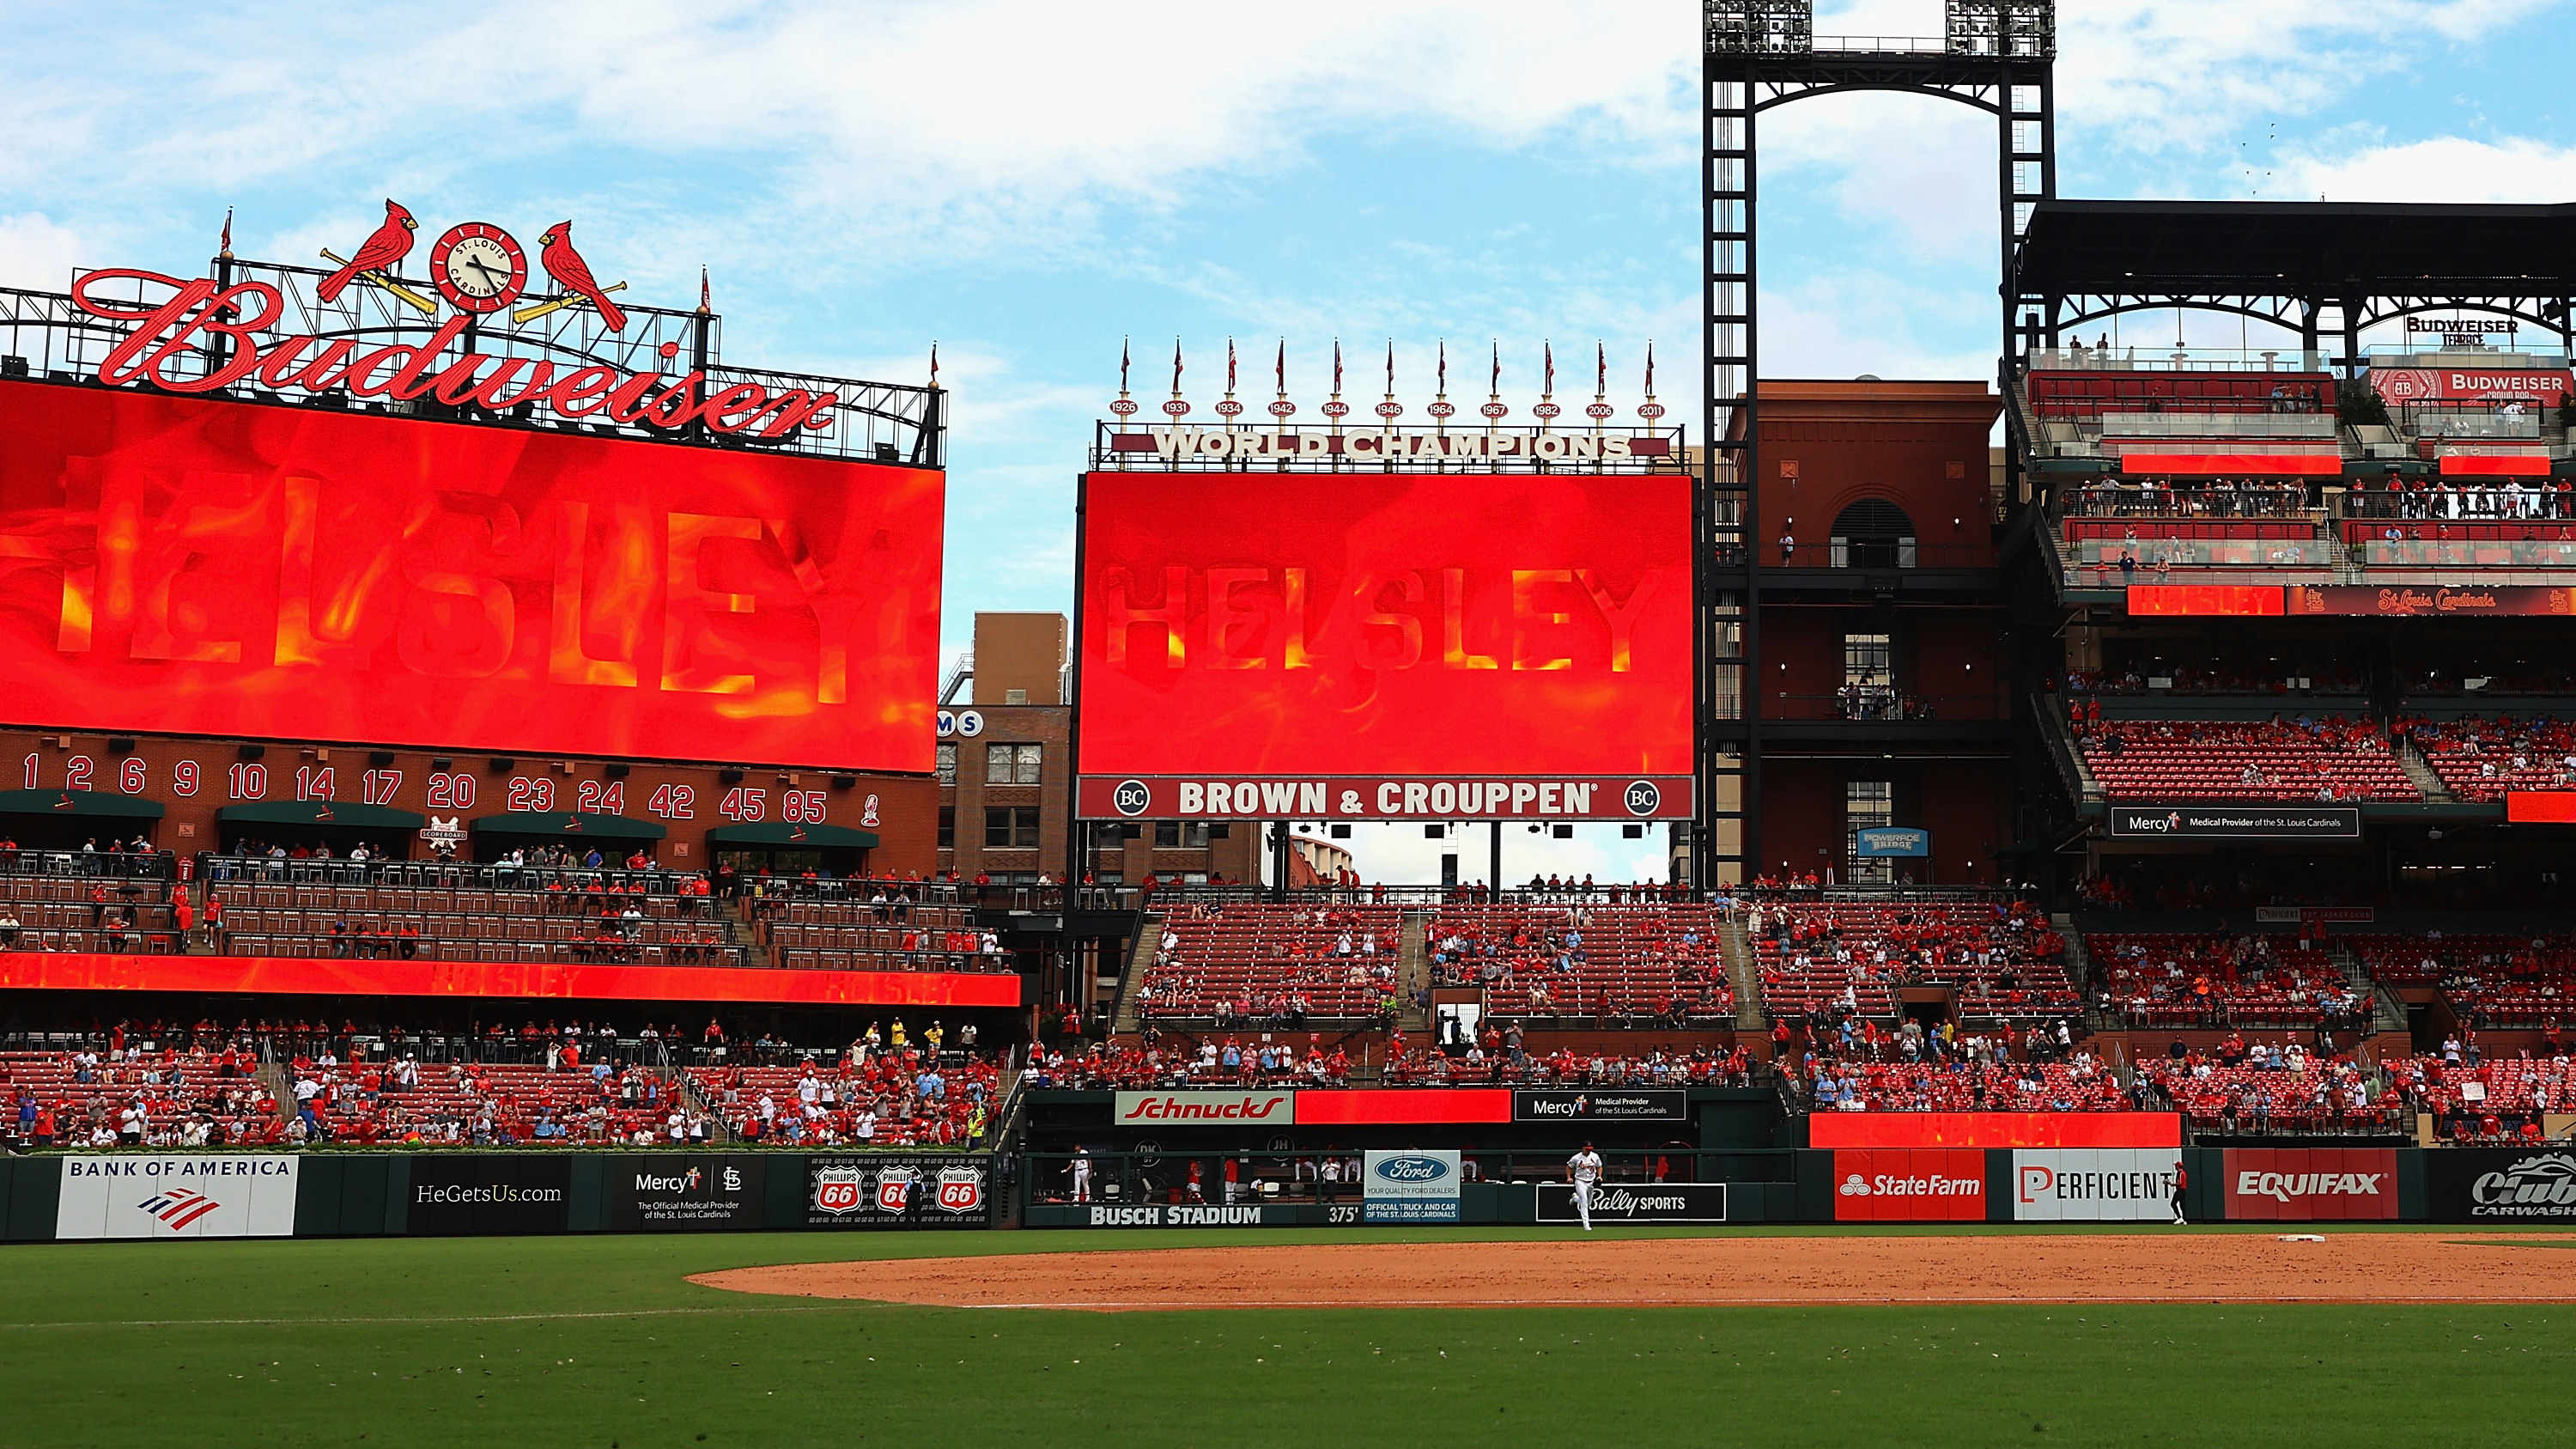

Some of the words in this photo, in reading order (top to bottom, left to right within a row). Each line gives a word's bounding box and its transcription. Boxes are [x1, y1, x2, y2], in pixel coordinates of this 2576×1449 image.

[456, 243, 471, 254] ST.
[474, 240, 506, 259] LOUIS
[451, 268, 508, 295] CARDINLS
[2407, 317, 2518, 333] BUDWEISER
[2442, 334, 2483, 345] TERRACE
[72, 267, 839, 439] Budweiser
[2451, 374, 2563, 390] BUDWEISER
[1112, 403, 1136, 412] 1926
[1165, 403, 1188, 412] 1931
[1218, 404, 1241, 412] 1934
[1270, 404, 1293, 413] 1942
[1323, 404, 1347, 413] 1944
[1377, 405, 1400, 414] 1946
[1430, 405, 1453, 414] 1964
[1483, 405, 1506, 415] 1967
[1535, 405, 1558, 415] 1982
[1588, 406, 1613, 416] 2006
[1640, 406, 1662, 416] 2011
[1151, 428, 1329, 460] WORLD
[1343, 429, 1631, 460] CHAMPIONS
[2397, 589, 2433, 612] Louis
[2436, 588, 2496, 611] Cardinals
[1106, 567, 1657, 673] HELSLEY
[25, 753, 39, 789] 1
[66, 756, 94, 792] 2
[120, 758, 146, 794] 6
[173, 760, 200, 796] 9
[229, 763, 267, 799] 10
[296, 766, 335, 801] 14
[363, 769, 403, 805] 17
[427, 773, 476, 808] 20
[507, 776, 555, 813] 23
[577, 780, 624, 815] 24
[1121, 789, 1144, 807] BC
[1179, 782, 1327, 814] BROWN
[1340, 789, 1364, 813] &
[1631, 789, 1655, 807] BC
[647, 783, 695, 819] 42
[720, 787, 766, 822] 45
[782, 790, 826, 825] 85
[2129, 817, 2169, 832] Mercy
[2190, 818, 2221, 826] Medical
[2221, 818, 2254, 826] Provider
[2255, 818, 2262, 826] of
[2263, 818, 2275, 826] the
[2276, 818, 2286, 826] St.
[2287, 818, 2306, 827] Louis
[2307, 819, 2341, 827] Cardinals
[1534, 1100, 1577, 1117] Mercy
[70, 1161, 137, 1177] BANK
[145, 1161, 175, 1176] OF
[181, 1161, 289, 1176] AMERICA
[823, 1173, 857, 1182] PHILLIPS
[884, 1173, 912, 1182] PHILLIP
[945, 1173, 975, 1182] PHILLIPS
[1389, 1160, 1435, 1178] Ford
[635, 1174, 688, 1193] Mercy
[2020, 1166, 2171, 1203] PERFICIENT
[2472, 1172, 2576, 1204] Club
[416, 1184, 562, 1202] HeGetsUs.com
[823, 1186, 854, 1203] 66
[945, 1186, 974, 1203] 66
[638, 1202, 652, 1210] The
[710, 1201, 739, 1209] Provider
[1640, 1197, 1686, 1210] SPORTS
[653, 1210, 665, 1219] the
[667, 1210, 677, 1219] St.
[678, 1210, 696, 1219] Louis
[698, 1210, 731, 1219] Cardinals
[1091, 1206, 1159, 1225] BUSCH
[1167, 1206, 1261, 1224] STADIUM
